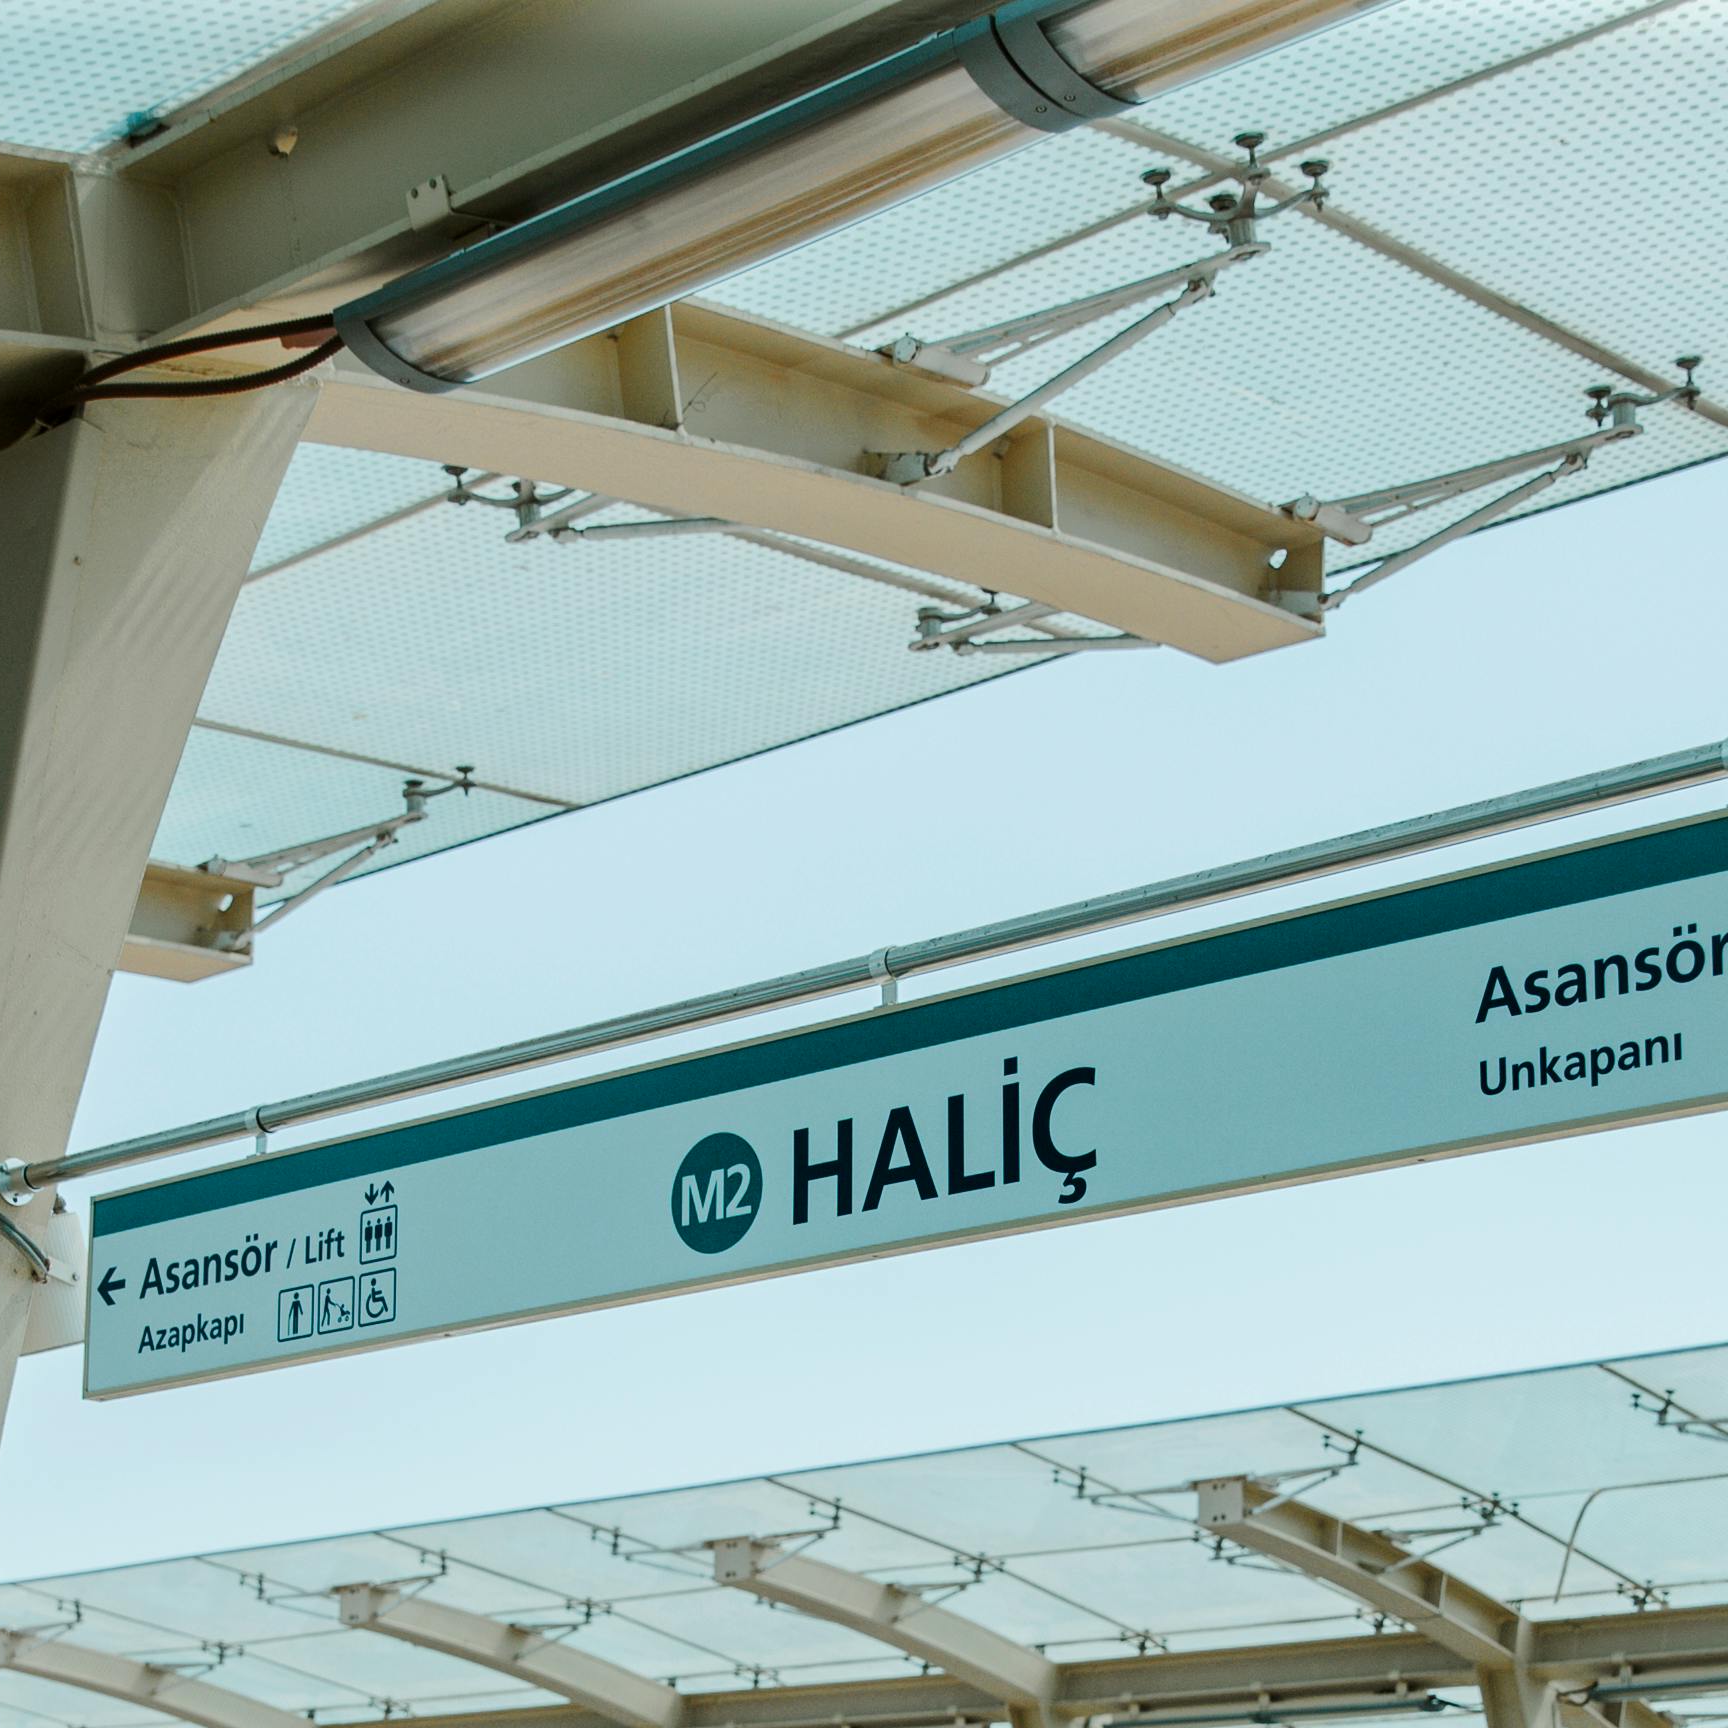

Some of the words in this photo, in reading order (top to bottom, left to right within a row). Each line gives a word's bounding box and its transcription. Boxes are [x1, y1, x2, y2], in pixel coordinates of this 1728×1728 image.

[1479, 1032, 1683, 1096] Unkapanı
[681, 1163, 752, 1227] M2
[792, 1055, 1098, 1226] HALİÇ
[139, 1233, 278, 1300] Asansör
[286, 1238, 297, 1269] /
[305, 1227, 345, 1265] Lift
[138, 1313, 244, 1354] Azapkapı
